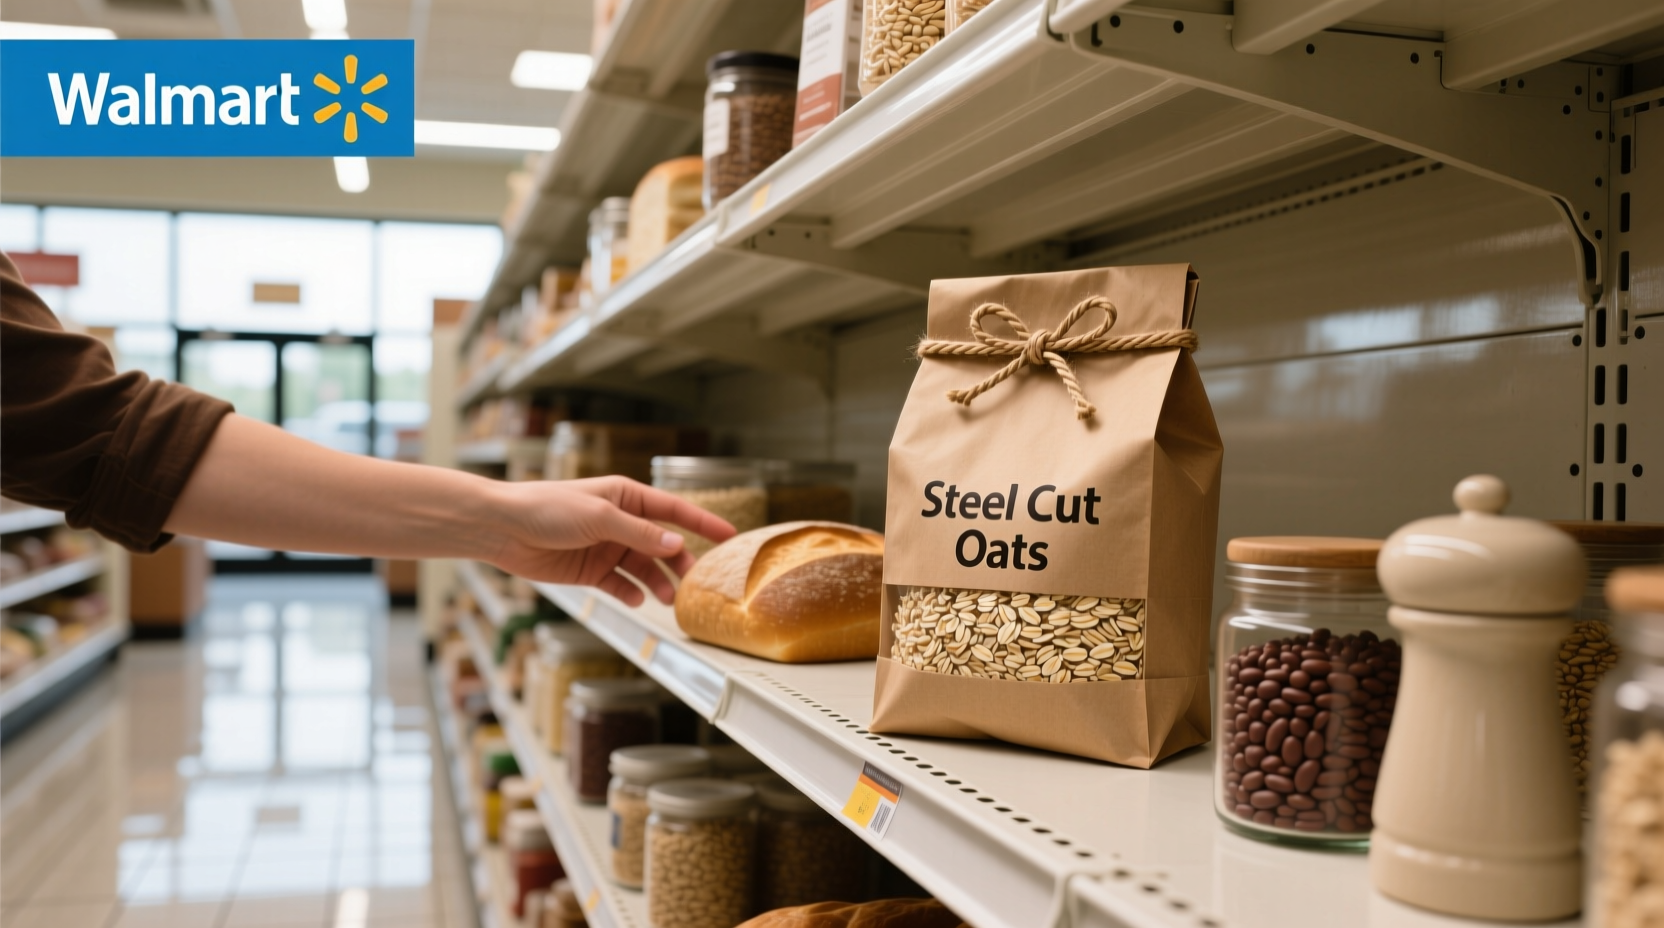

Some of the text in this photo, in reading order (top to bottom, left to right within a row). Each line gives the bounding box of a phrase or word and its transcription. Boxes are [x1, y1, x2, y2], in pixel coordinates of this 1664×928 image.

[921, 480, 1102, 525] Steel Cut
[955, 529, 1049, 572] Oats
